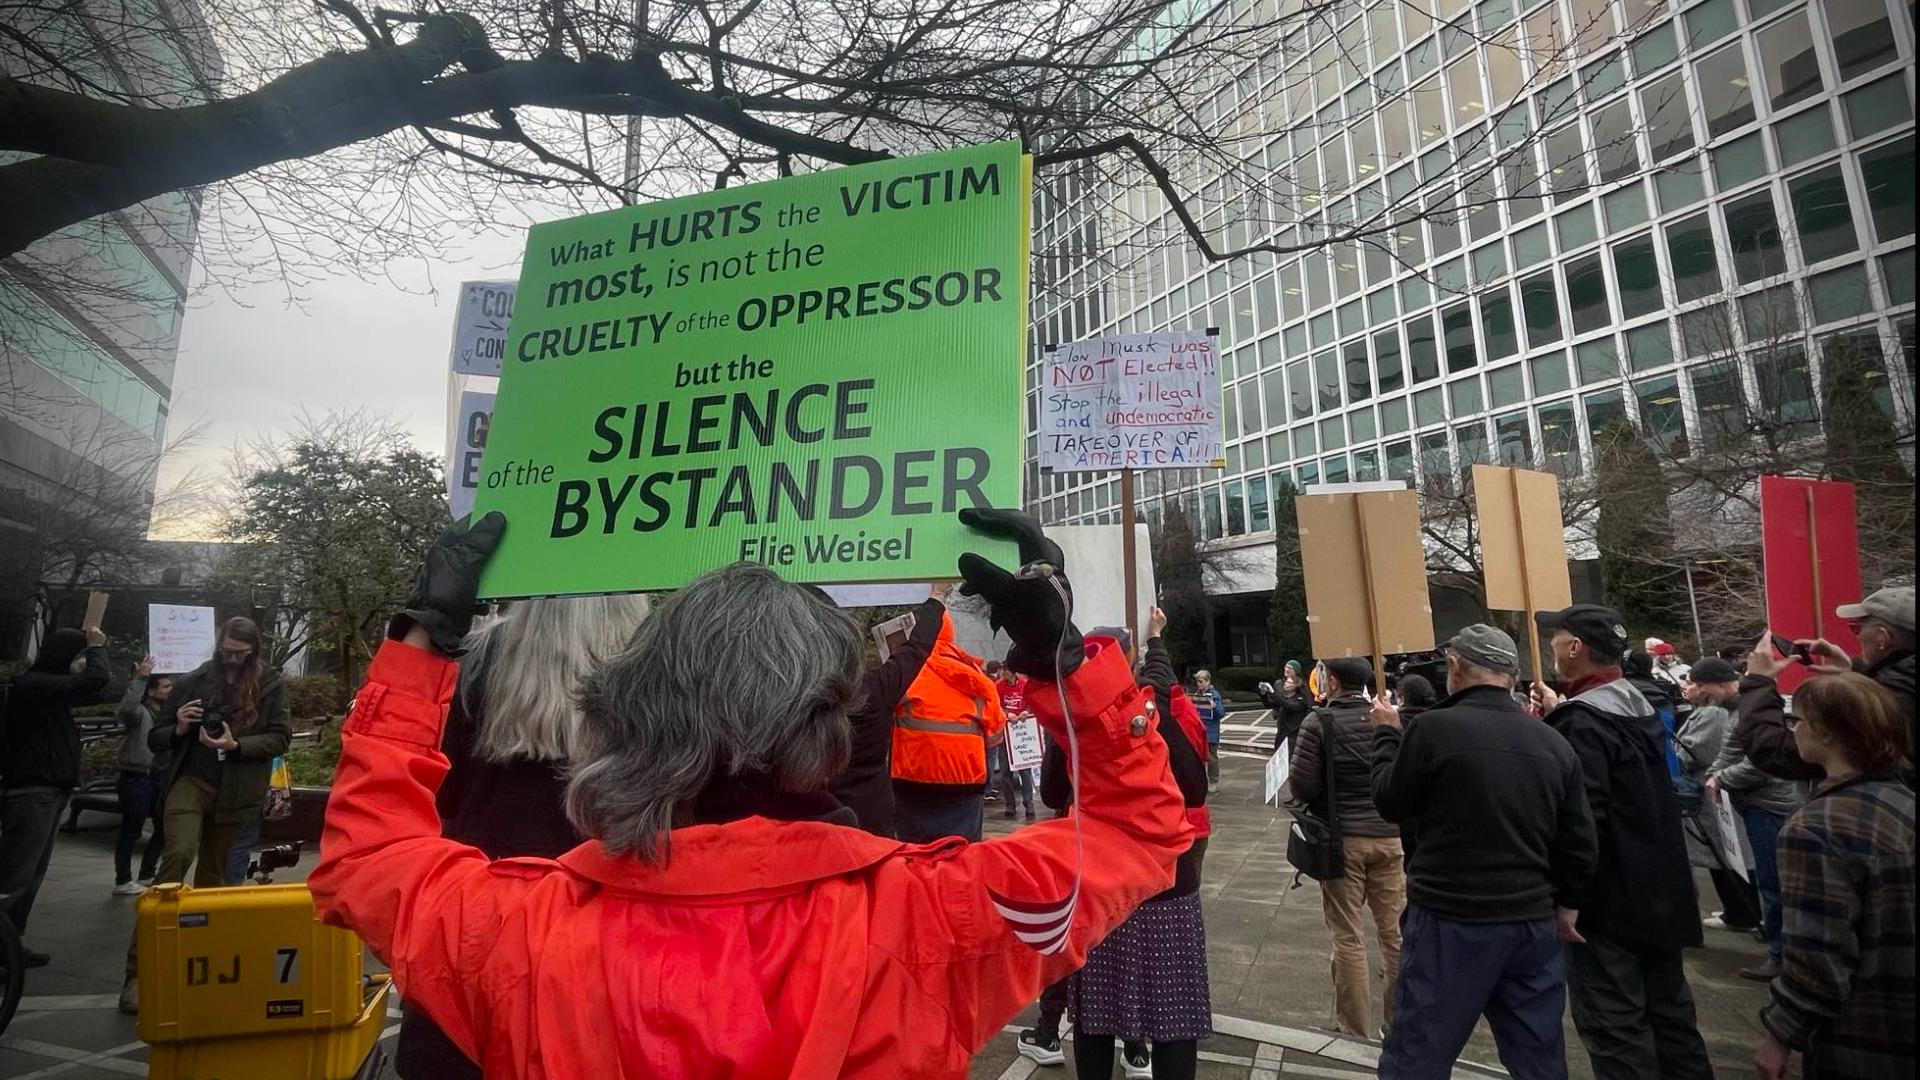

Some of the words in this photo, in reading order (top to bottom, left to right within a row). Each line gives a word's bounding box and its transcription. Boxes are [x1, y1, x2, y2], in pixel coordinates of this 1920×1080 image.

[550, 238, 615, 266] What
[628, 200, 763, 253] HURTS
[777, 204, 820, 228] the
[839, 163, 1000, 217] VICTIM
[546, 263, 655, 308] most,
[666, 258, 690, 289] is
[699, 250, 758, 283] not
[766, 238, 825, 273] the
[517, 310, 674, 364] CRUELTY
[675, 313, 698, 333] of
[699, 309, 730, 330] the
[736, 268, 1002, 332] OPPRESSOR
[1102, 337, 1159, 358] Musk
[1171, 341, 1210, 354] was
[1124, 354, 1216, 377] Elected!!
[675, 362, 722, 388] but
[727, 354, 774, 382] the
[1048, 394, 1090, 413] Stop
[1095, 389, 1128, 406] the
[1136, 380, 1202, 408] illegal
[588, 379, 876, 463] SILENCE
[1056, 414, 1091, 428] and
[1106, 407, 1215, 425] undemocratic
[1048, 431, 1164, 453] TAKEOVER
[1175, 431, 1198, 446] OF
[487, 461, 515, 489] of
[516, 459, 555, 486] the
[550, 448, 992, 538] BYSTANDER
[737, 536, 796, 566] Elie
[804, 528, 912, 564] Weisel
[276, 948, 298, 984] 7
